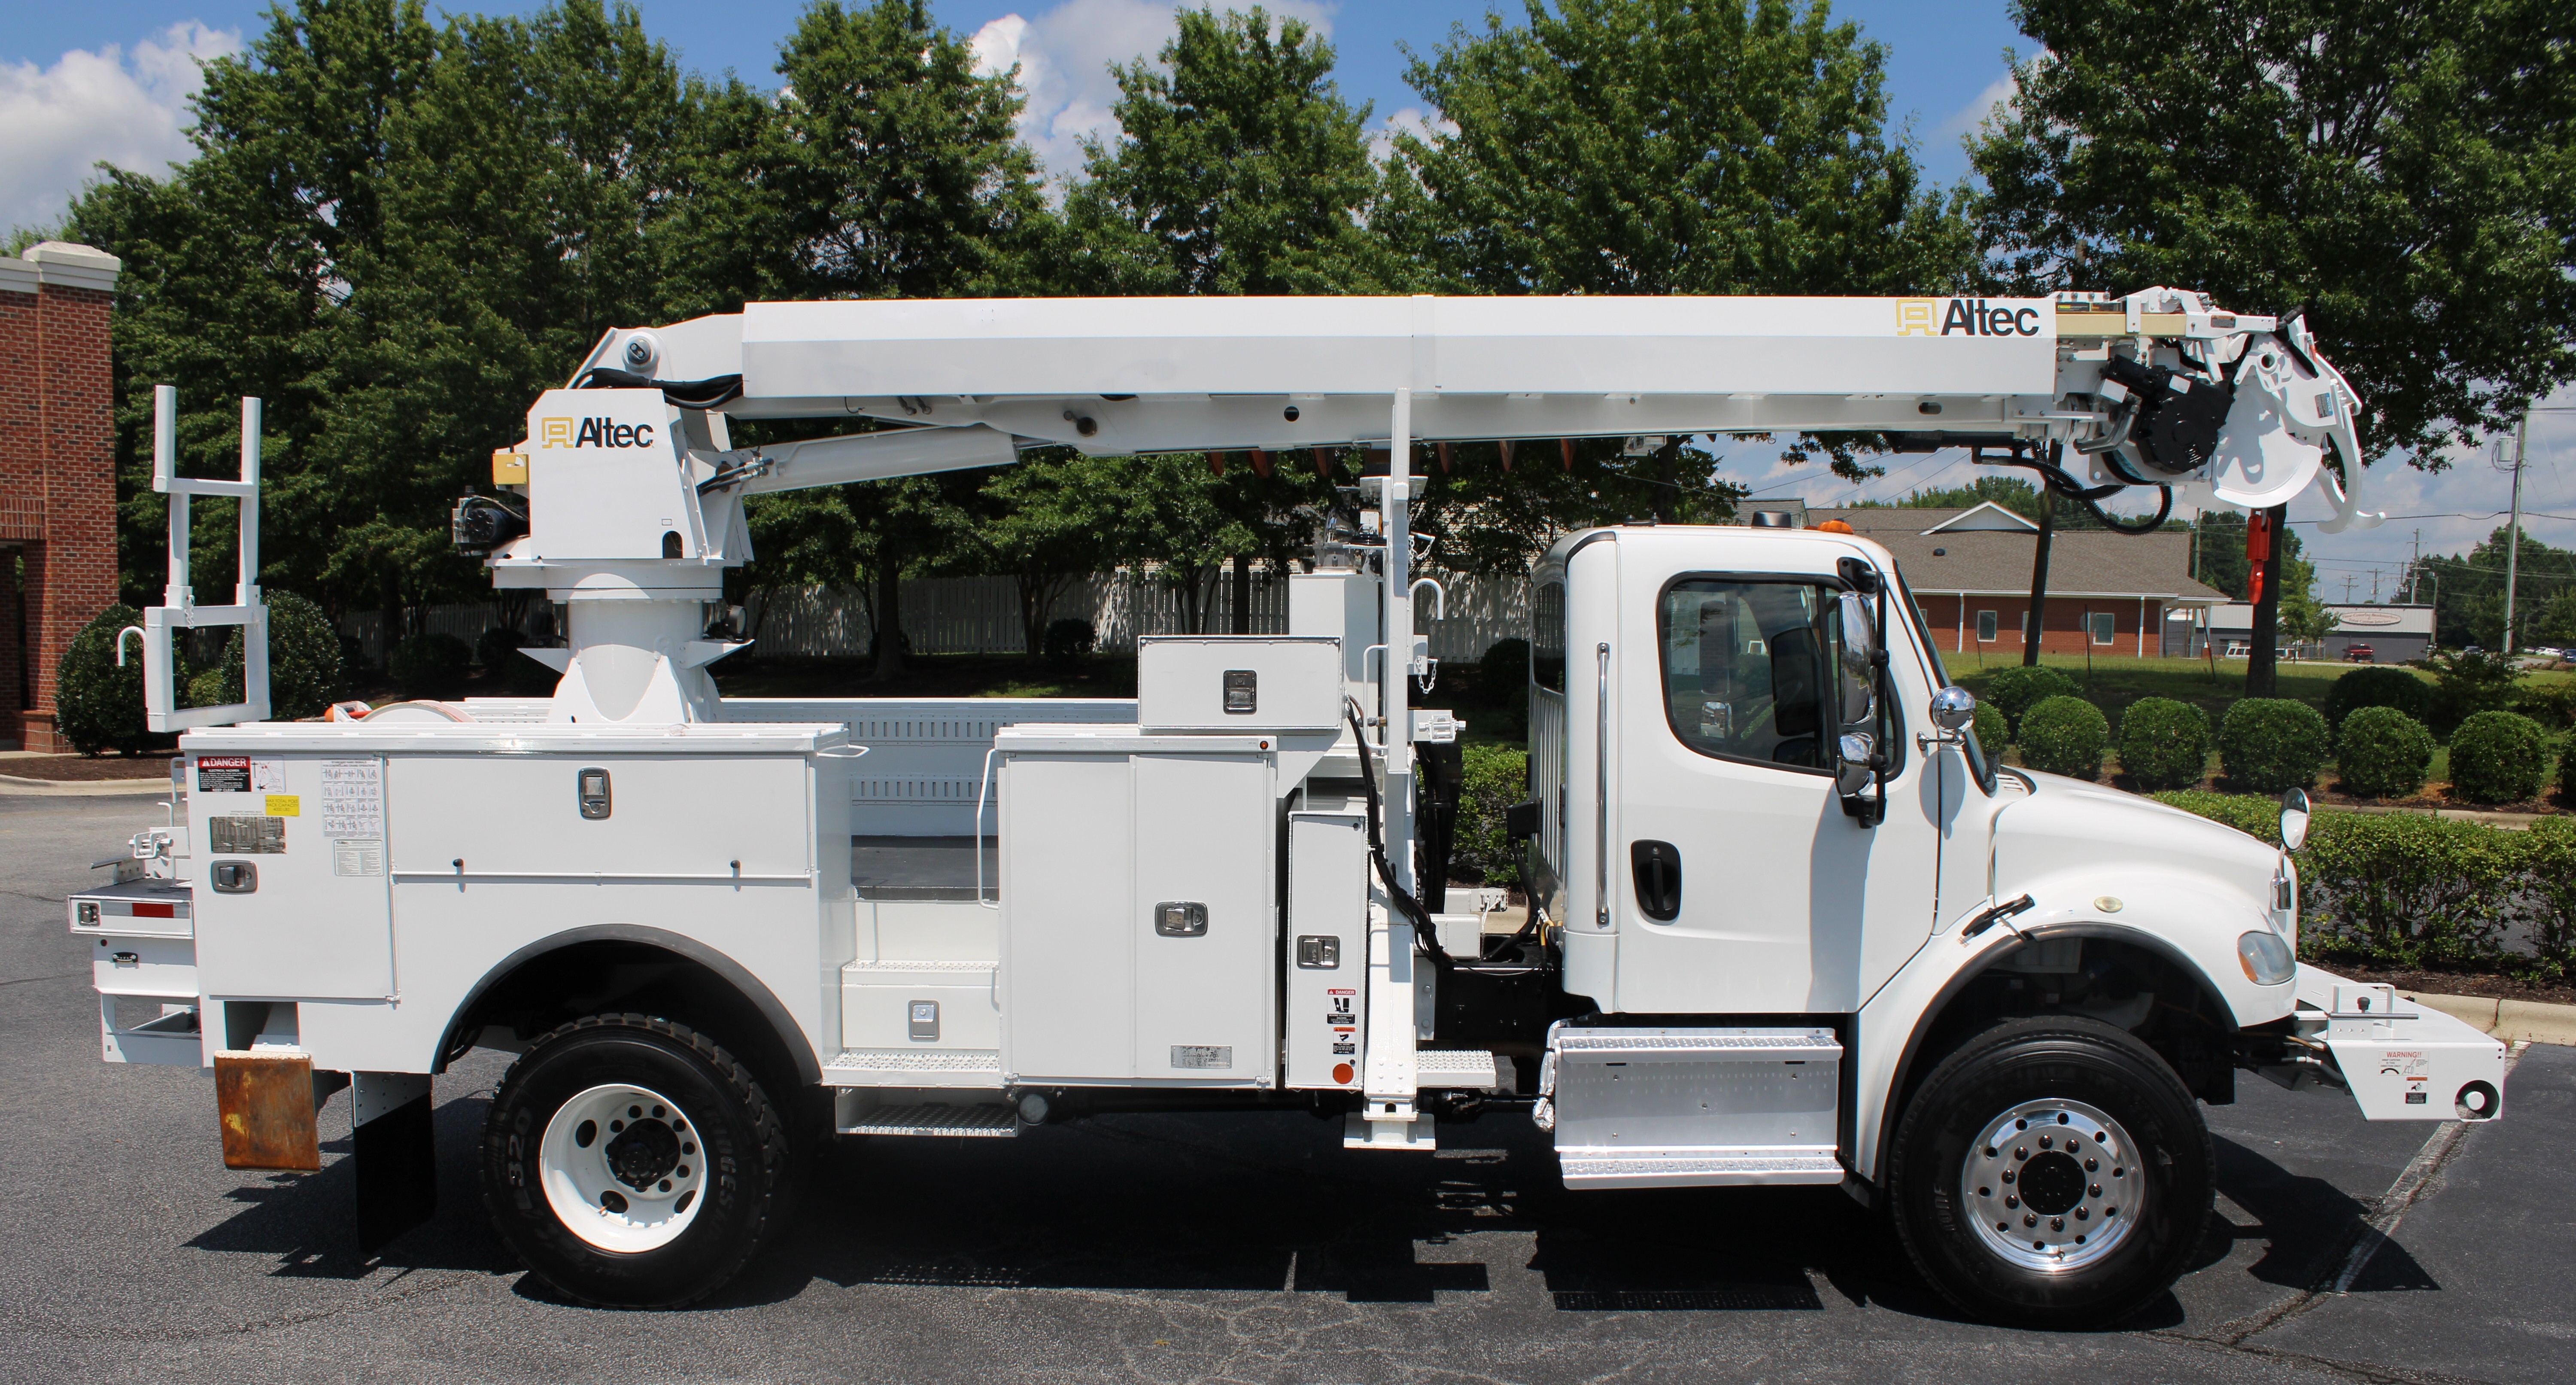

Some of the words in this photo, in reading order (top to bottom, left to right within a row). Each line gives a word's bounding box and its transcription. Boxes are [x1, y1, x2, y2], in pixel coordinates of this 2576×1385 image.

[1941, 299, 2039, 336] Altec
[575, 417, 654, 448] Altec
[210, 758, 246, 767] DANGER
